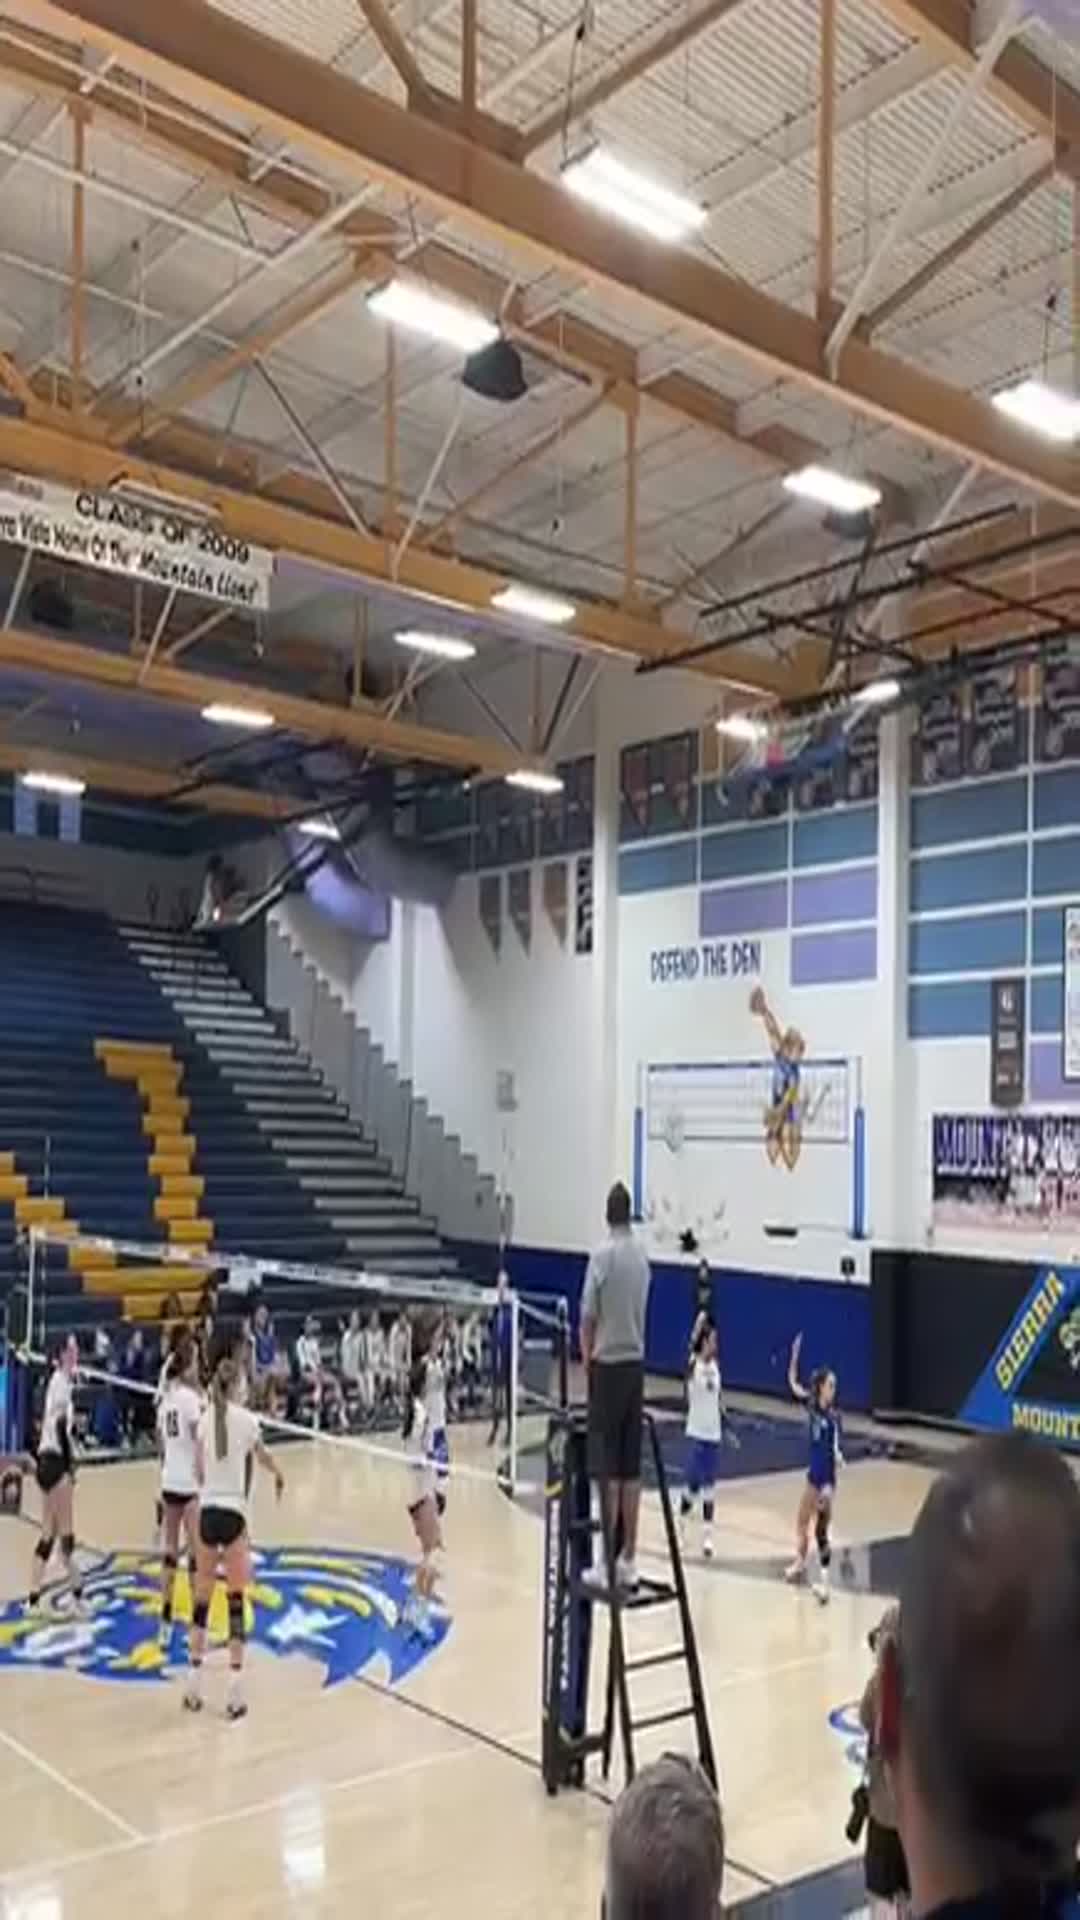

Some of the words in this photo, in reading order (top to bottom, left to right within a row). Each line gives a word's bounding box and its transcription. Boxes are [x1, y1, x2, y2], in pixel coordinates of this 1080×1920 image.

[76, 492, 154, 535] CLASS
[161, 517, 191, 544] OF
[198, 526, 250, 565] 2009
[650, 946, 700, 985] DEFEND
[702, 942, 729, 977] THE
[732, 939, 762, 977] DEN
[995, 1270, 1066, 1391] SIERRA
